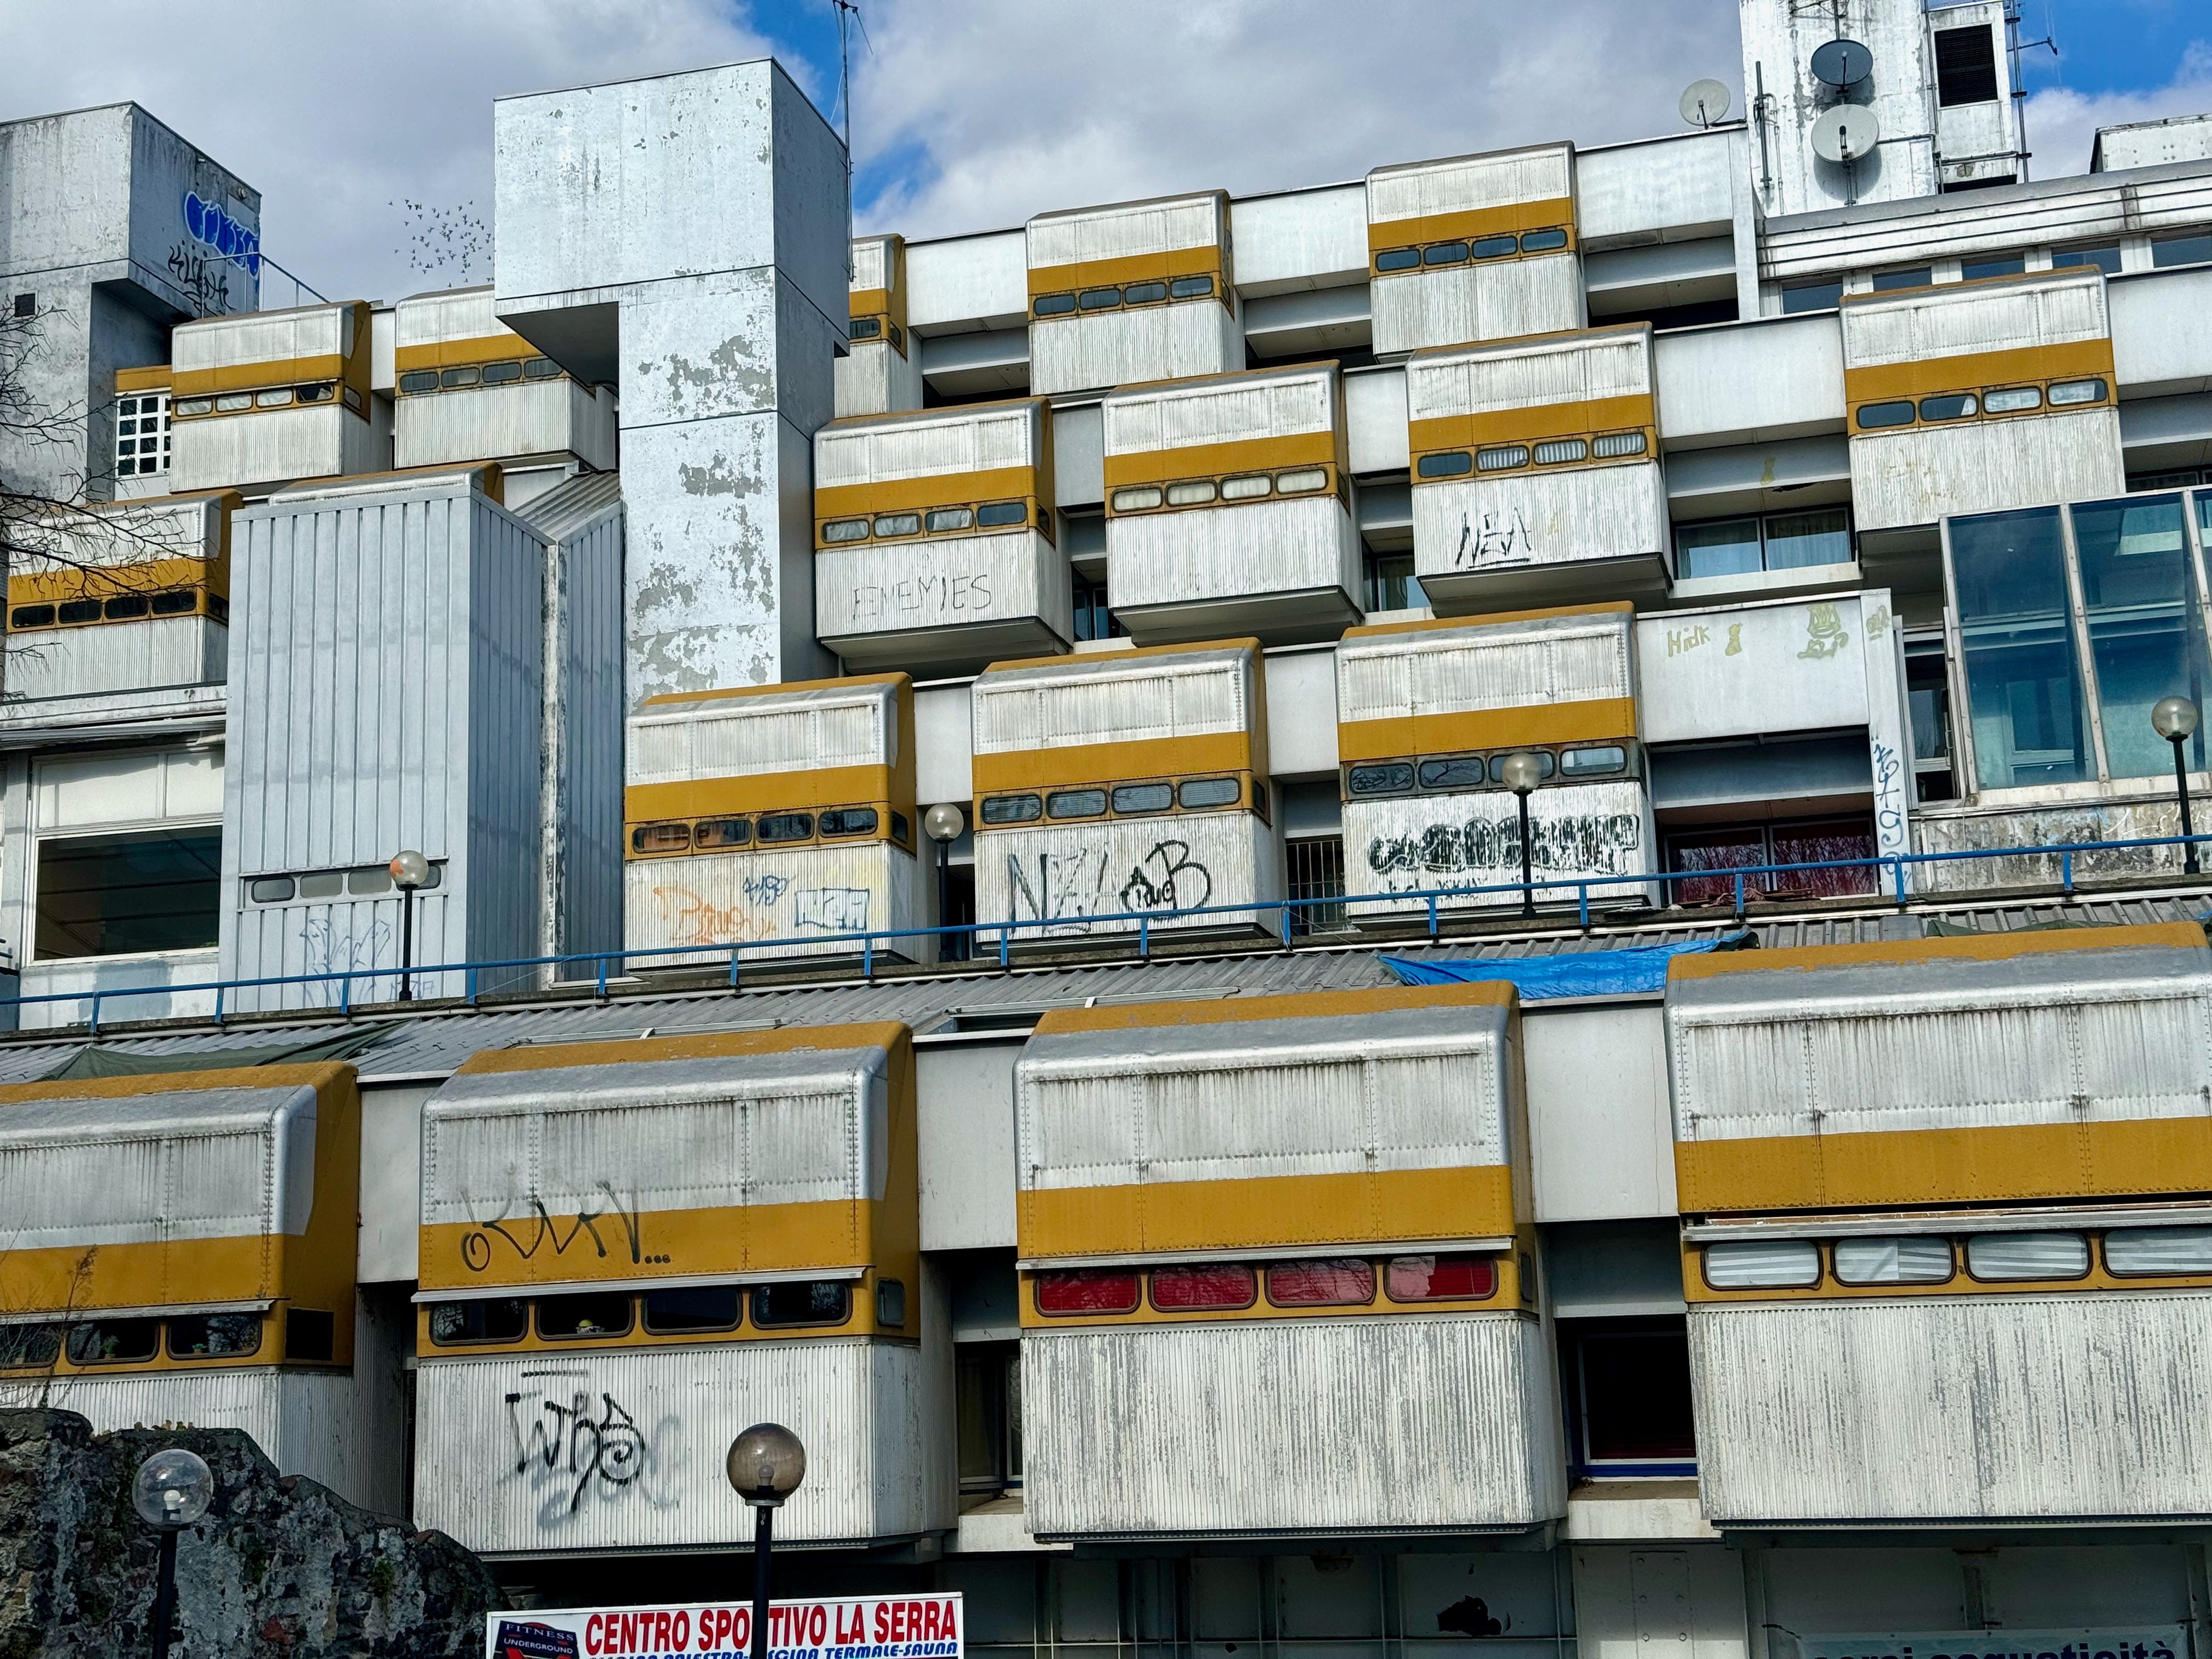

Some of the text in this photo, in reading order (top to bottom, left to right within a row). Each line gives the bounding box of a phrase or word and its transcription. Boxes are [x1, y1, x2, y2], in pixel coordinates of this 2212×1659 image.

[853, 574, 991, 620] ENEMIES
[506, 1623, 574, 1641] FITNESS
[585, 1600, 957, 1655] CENTRO SPOTIVO LA SERRA
[504, 1638, 573, 1654] UNDERGROUND
